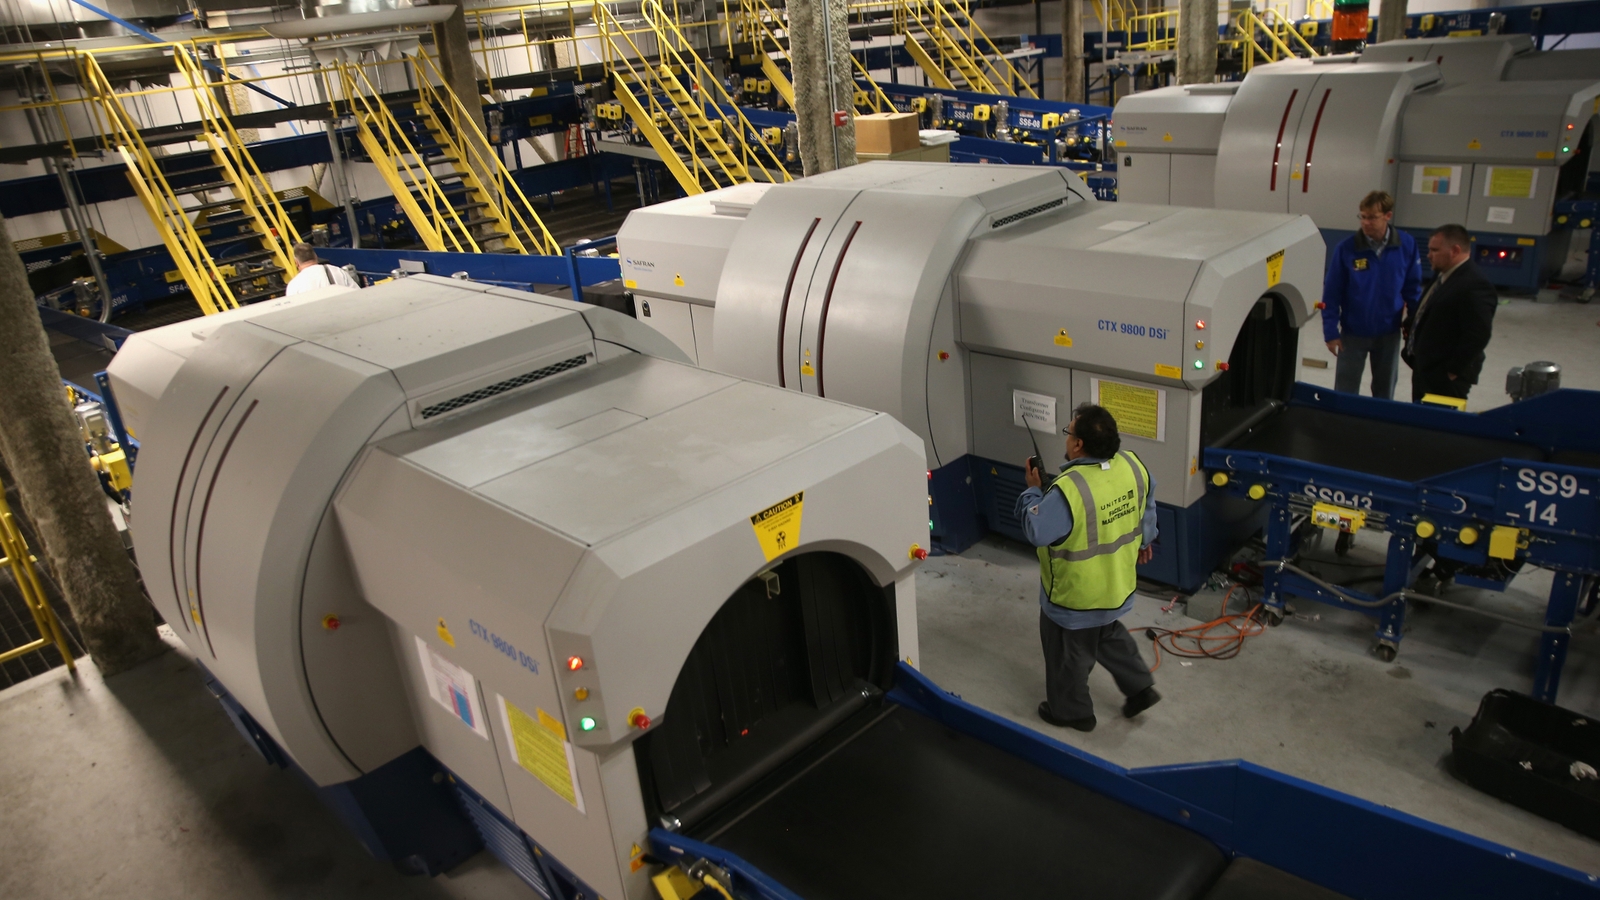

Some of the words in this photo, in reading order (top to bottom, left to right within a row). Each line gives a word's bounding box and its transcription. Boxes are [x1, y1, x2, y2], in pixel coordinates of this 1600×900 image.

[632, 260, 655, 268] SAFRAN
[1097, 319, 1118, 332] CTX
[1120, 322, 1146, 337] 9800
[763, 498, 793, 519] CAUTION
[1100, 494, 1127, 510] UNITED
[1108, 502, 1130, 517] FACILITY
[1102, 505, 1136, 526] MAINTENANCE
[469, 618, 490, 643] CTX
[490, 633, 517, 661] 9800
